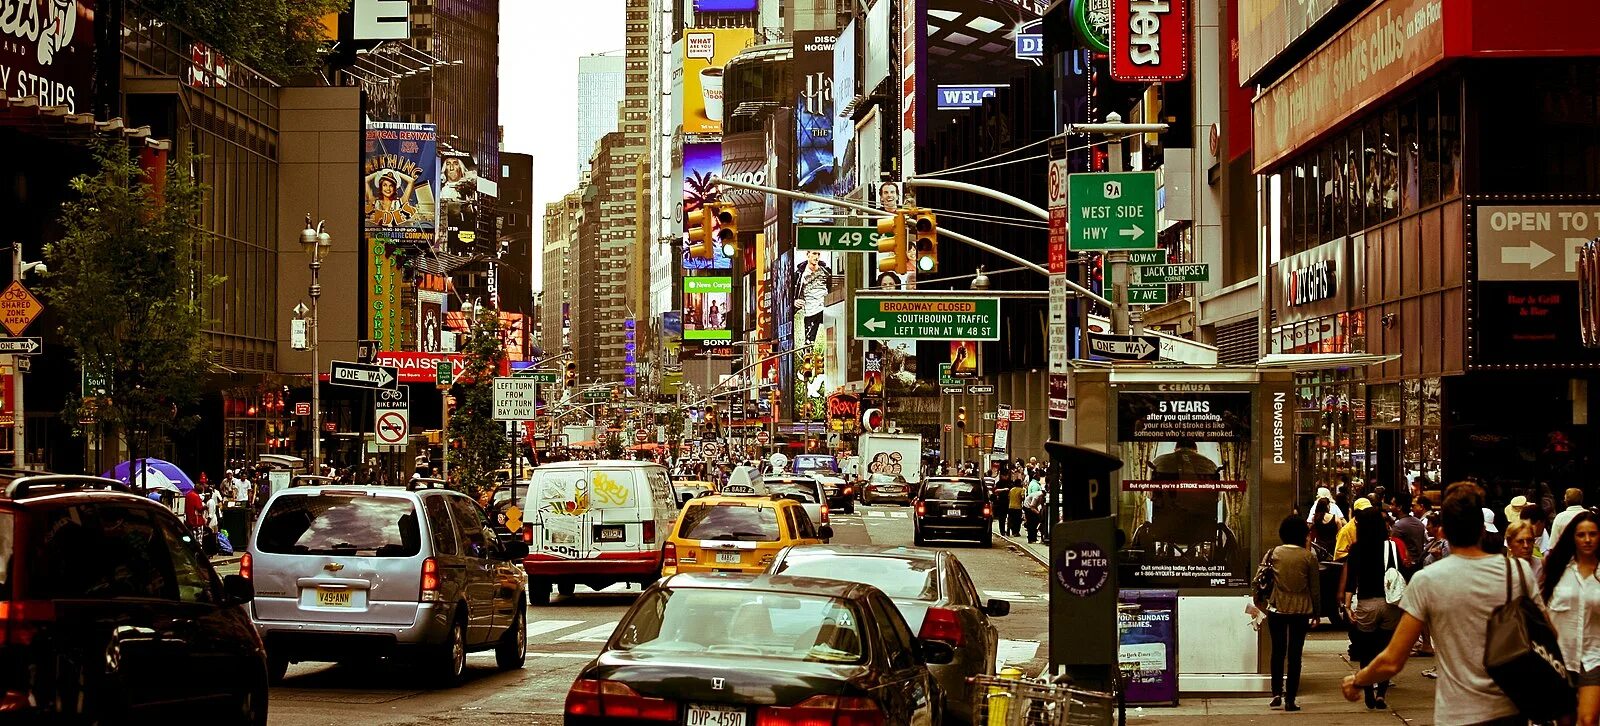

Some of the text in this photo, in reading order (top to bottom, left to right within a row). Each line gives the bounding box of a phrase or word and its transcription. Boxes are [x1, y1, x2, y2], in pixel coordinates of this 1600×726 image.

[1334, 39, 1367, 110] sports
[1371, 8, 1403, 75] clubs
[18, 70, 75, 115] STRIPS
[1106, 183, 1120, 196] 9A
[1082, 205, 1144, 218] WEST SIDE
[1490, 212, 1588, 231] OPEN TO
[818, 232, 832, 246] W
[839, 232, 862, 246] 49
[1083, 227, 1108, 240] HWY
[374, 245, 385, 294] OLIVE
[1144, 265, 1206, 277] JACK DEMPSEY
[487, 262, 495, 293] 1500
[1309, 260, 1328, 302] GIFTS
[1133, 290, 1158, 299] 7 AVE
[1, 301, 31, 309] SHARED
[884, 303, 971, 311] BROADWAY CLOSED
[897, 315, 989, 323] SOUTHBOUND TRAFFIC
[894, 327, 991, 335] LEFT TURN AT W 48 ST
[20, 341, 35, 349] WAY
[1097, 341, 1149, 353] ONE WAY
[340, 369, 388, 383] ONE WAY
[505, 391, 524, 399] FROM
[497, 408, 531, 416] BAY ONLY
[1160, 401, 1210, 413] 5 YEARS
[1178, 413, 1190, 421] quit
[1192, 413, 1222, 421] smoking,
[1144, 422, 1158, 430] your
[1182, 421, 1204, 429] stroke
[1205, 421, 1211, 429] is
[1213, 421, 1225, 429] like
[1273, 392, 1286, 464] Newsstand
[1089, 480, 1098, 510] P
[1066, 550, 1077, 567] P
[1079, 578, 1085, 586] &
